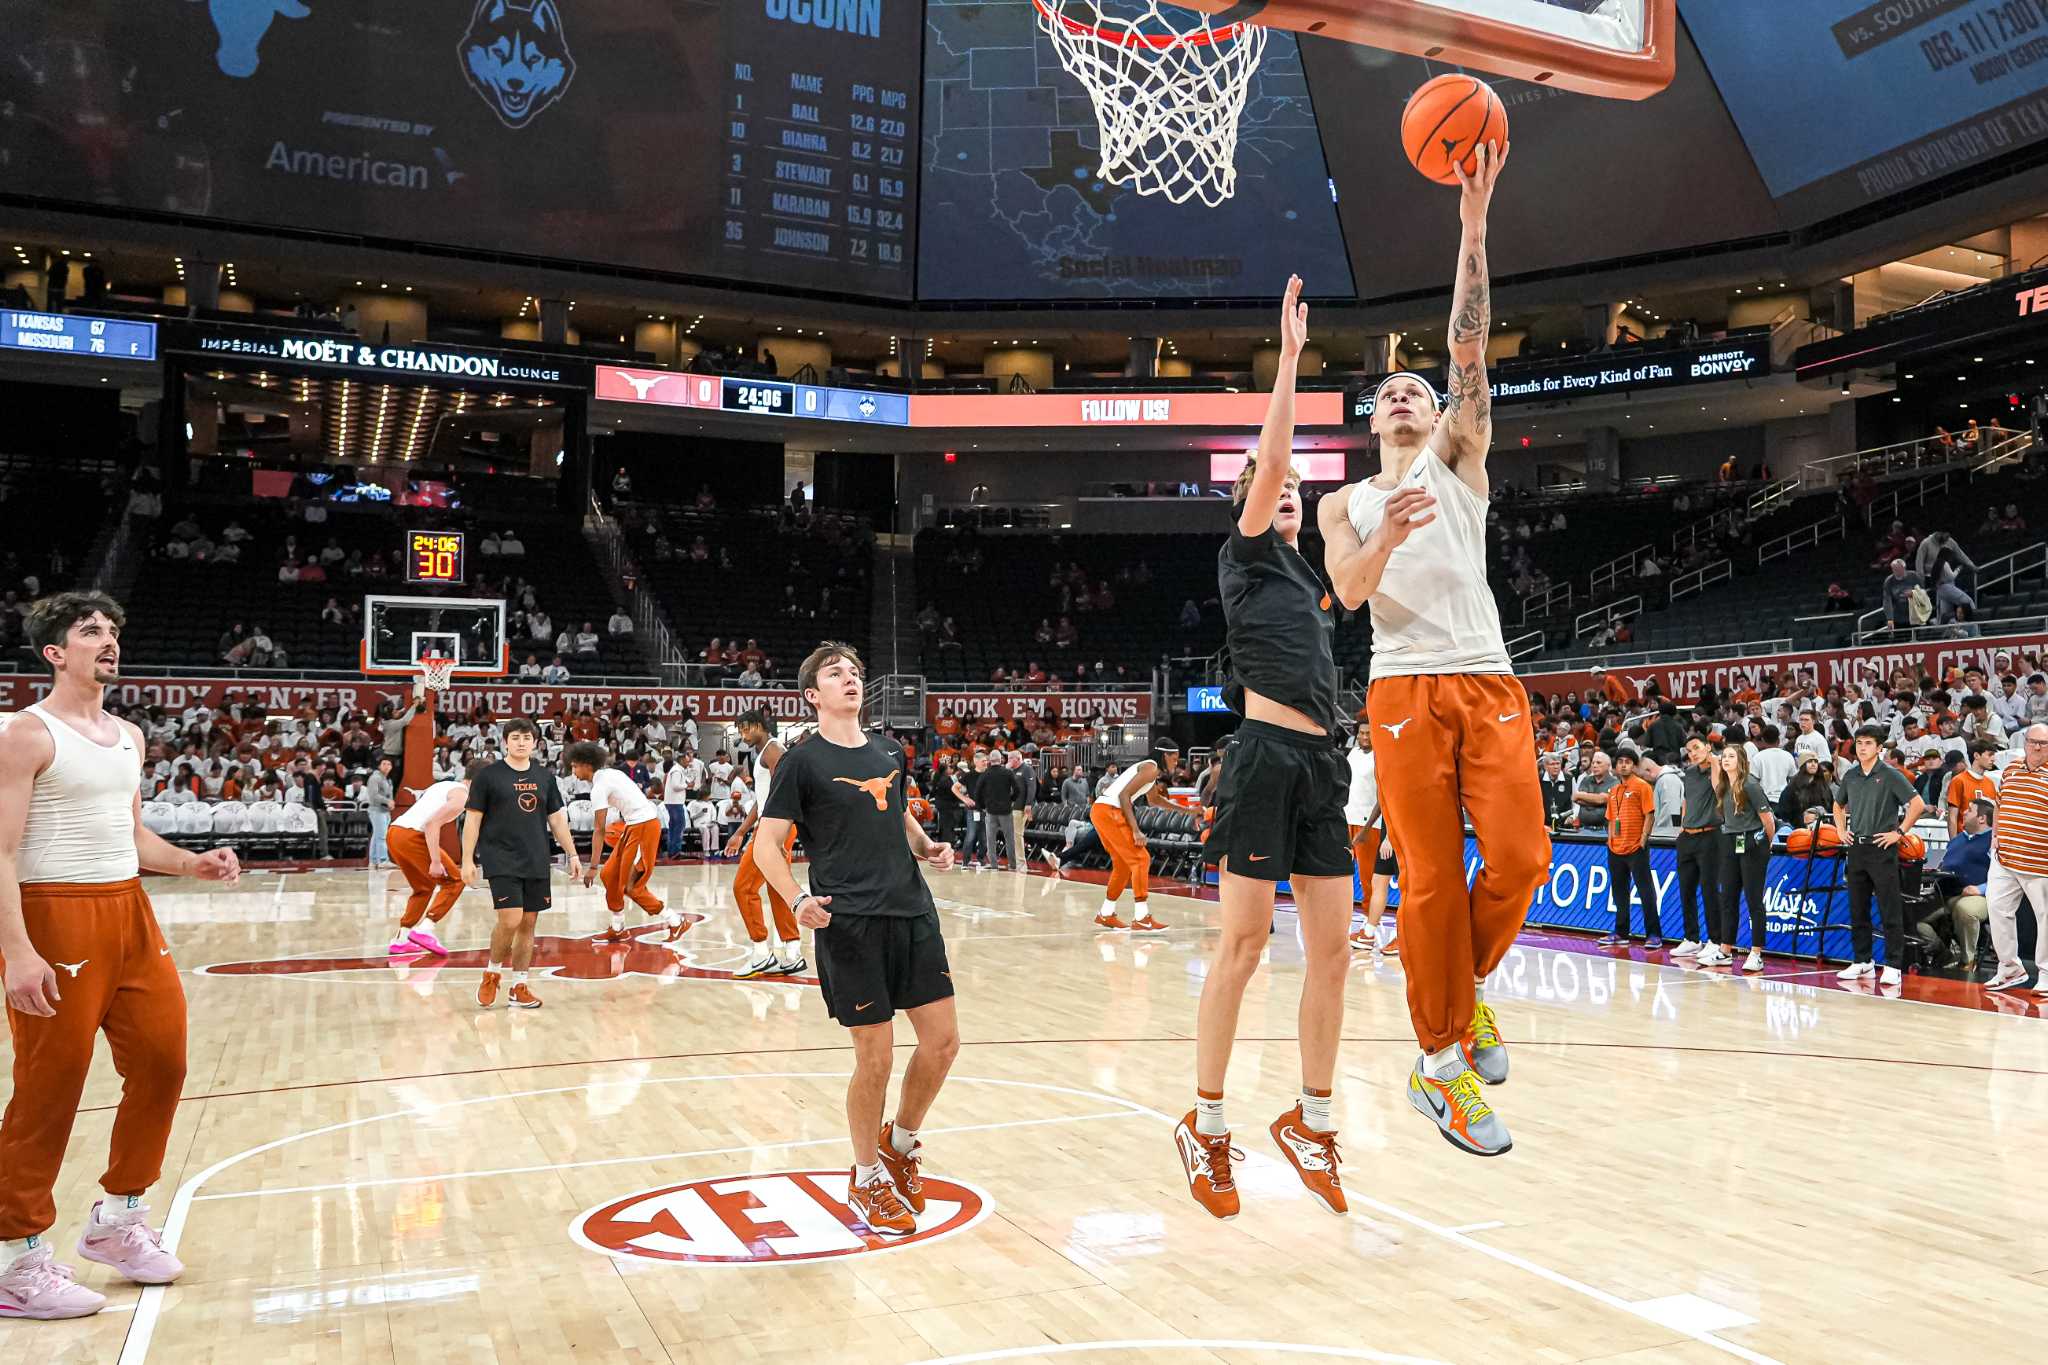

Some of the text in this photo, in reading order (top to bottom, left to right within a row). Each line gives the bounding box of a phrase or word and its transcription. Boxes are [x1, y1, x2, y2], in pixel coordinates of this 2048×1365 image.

[1920, 30, 1968, 72] DEC.
[735, 63, 907, 110] NO. NAME PPG MPG
[736, 94, 743, 109] 1
[792, 103, 819, 123] BALL
[731, 122, 745, 139] 10
[880, 146, 904, 165] 21.7
[265, 141, 428, 190] American
[1857, 156, 1913, 196] PROUD
[1909, 123, 1989, 177] SPONSOR
[1984, 117, 2013, 147] OF
[732, 154, 742, 172] 3
[775, 160, 832, 186] STEWART
[852, 173, 869, 193] 6.1
[730, 187, 742, 206] 11
[847, 204, 872, 226] 15.9
[876, 210, 904, 231] 32.4
[725, 220, 743, 241] 35
[850, 238, 867, 258] 7.2
[18, 314, 64, 332] KANSAS
[90, 320, 106, 336] 67
[17, 331, 139, 355] MISSOURI 76 F
[201, 337, 560, 381] IMPÉRIAL MOËT & CHANDON LOUNGE
[1691, 358, 1751, 377] BONVOY
[1699, 351, 1744, 363] MARRIOTT
[699, 380, 711, 401] 0
[1500, 380, 1541, 397] Brands
[1543, 376, 1561, 391] for
[1563, 373, 1597, 390] Every
[1600, 369, 1631, 384] Kind
[1633, 366, 1647, 382] of
[1649, 365, 1673, 379] Fan
[738, 386, 782, 408] 24:06
[805, 390, 818, 412] 0
[1082, 400, 1169, 422] FOLLOW US!
[414, 535, 459, 552] 24:06
[419, 551, 453, 577] 30
[521, 692, 553, 714] OF
[937, 698, 1138, 718] HOOK 'EM HORNS
[513, 783, 537, 791] TEXAS
